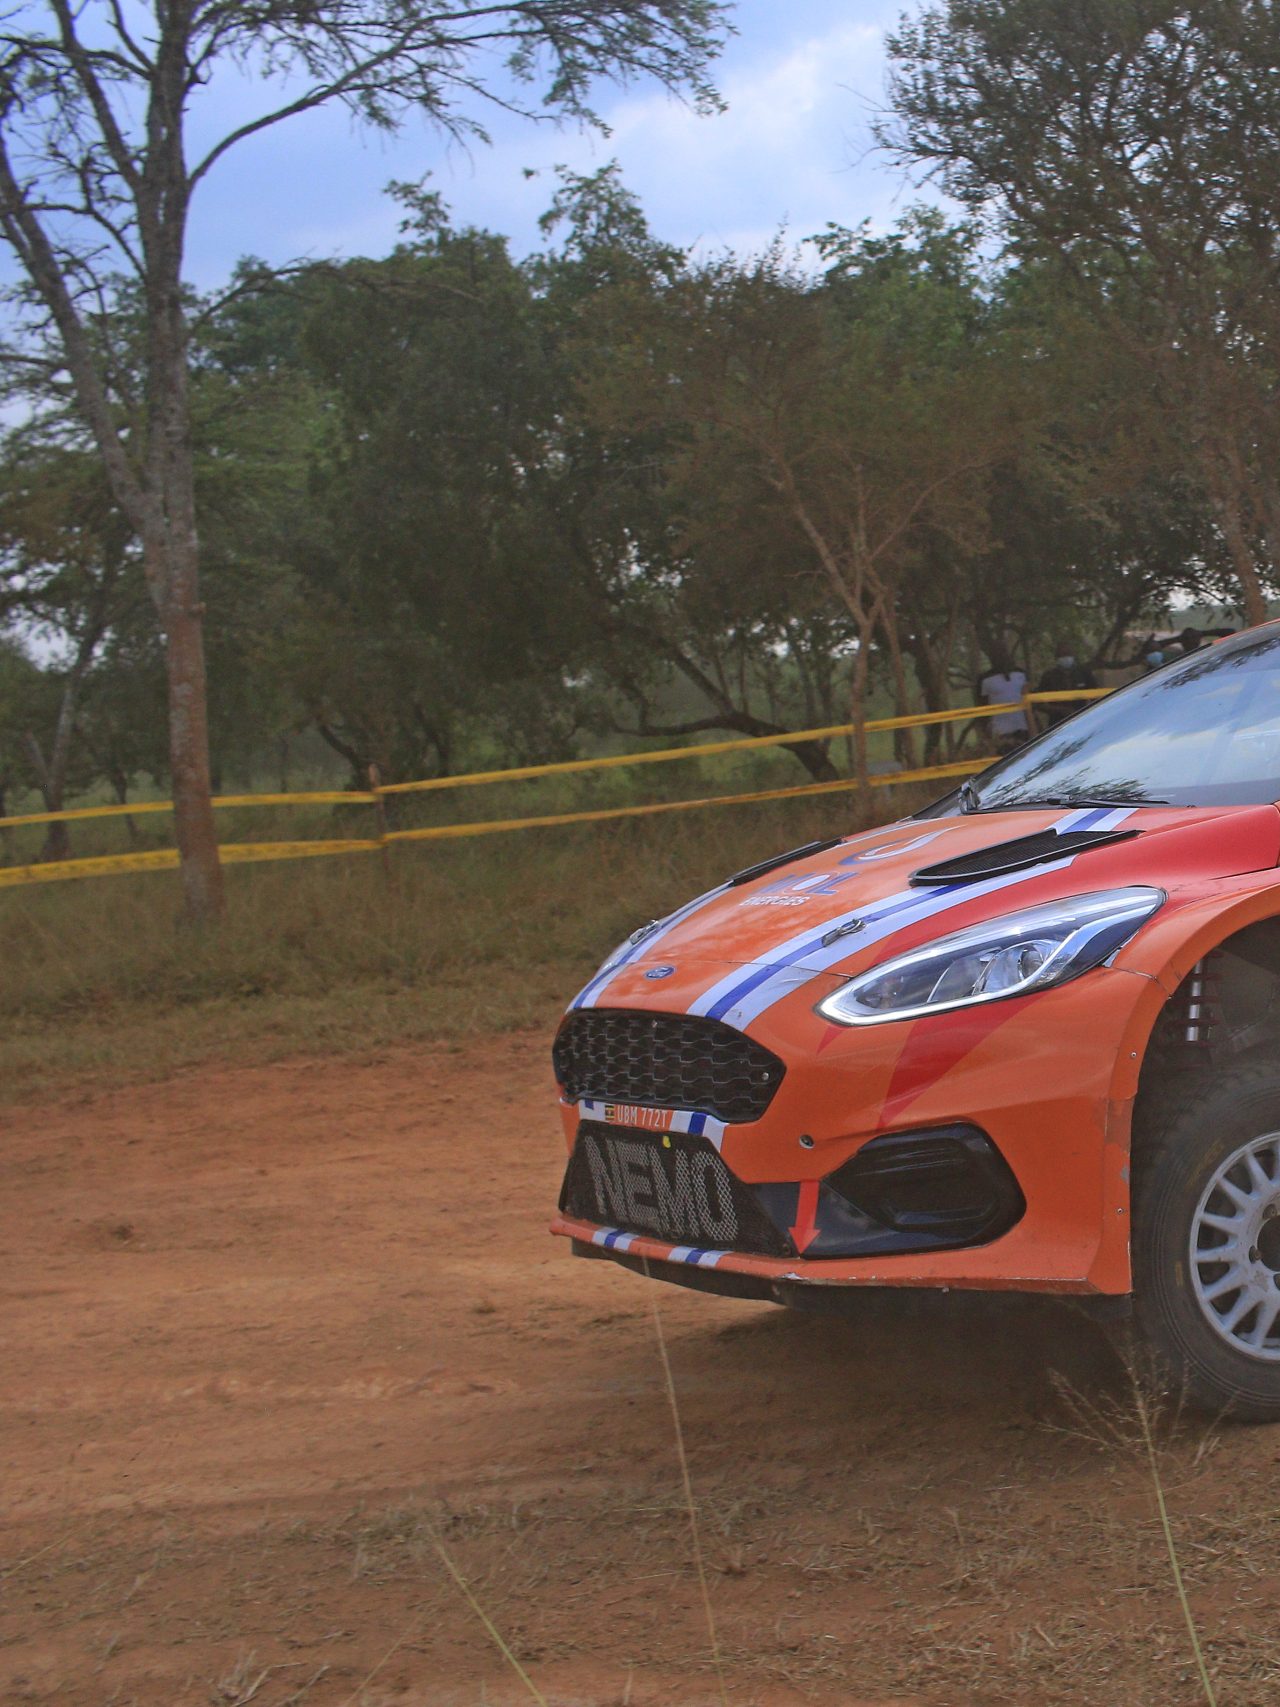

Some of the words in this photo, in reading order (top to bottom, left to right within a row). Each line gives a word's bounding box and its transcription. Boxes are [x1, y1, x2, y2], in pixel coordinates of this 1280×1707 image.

[616, 1104, 638, 1124] UBM
[641, 1107, 668, 1128] 772T
[585, 1135, 739, 1241] NEMO
